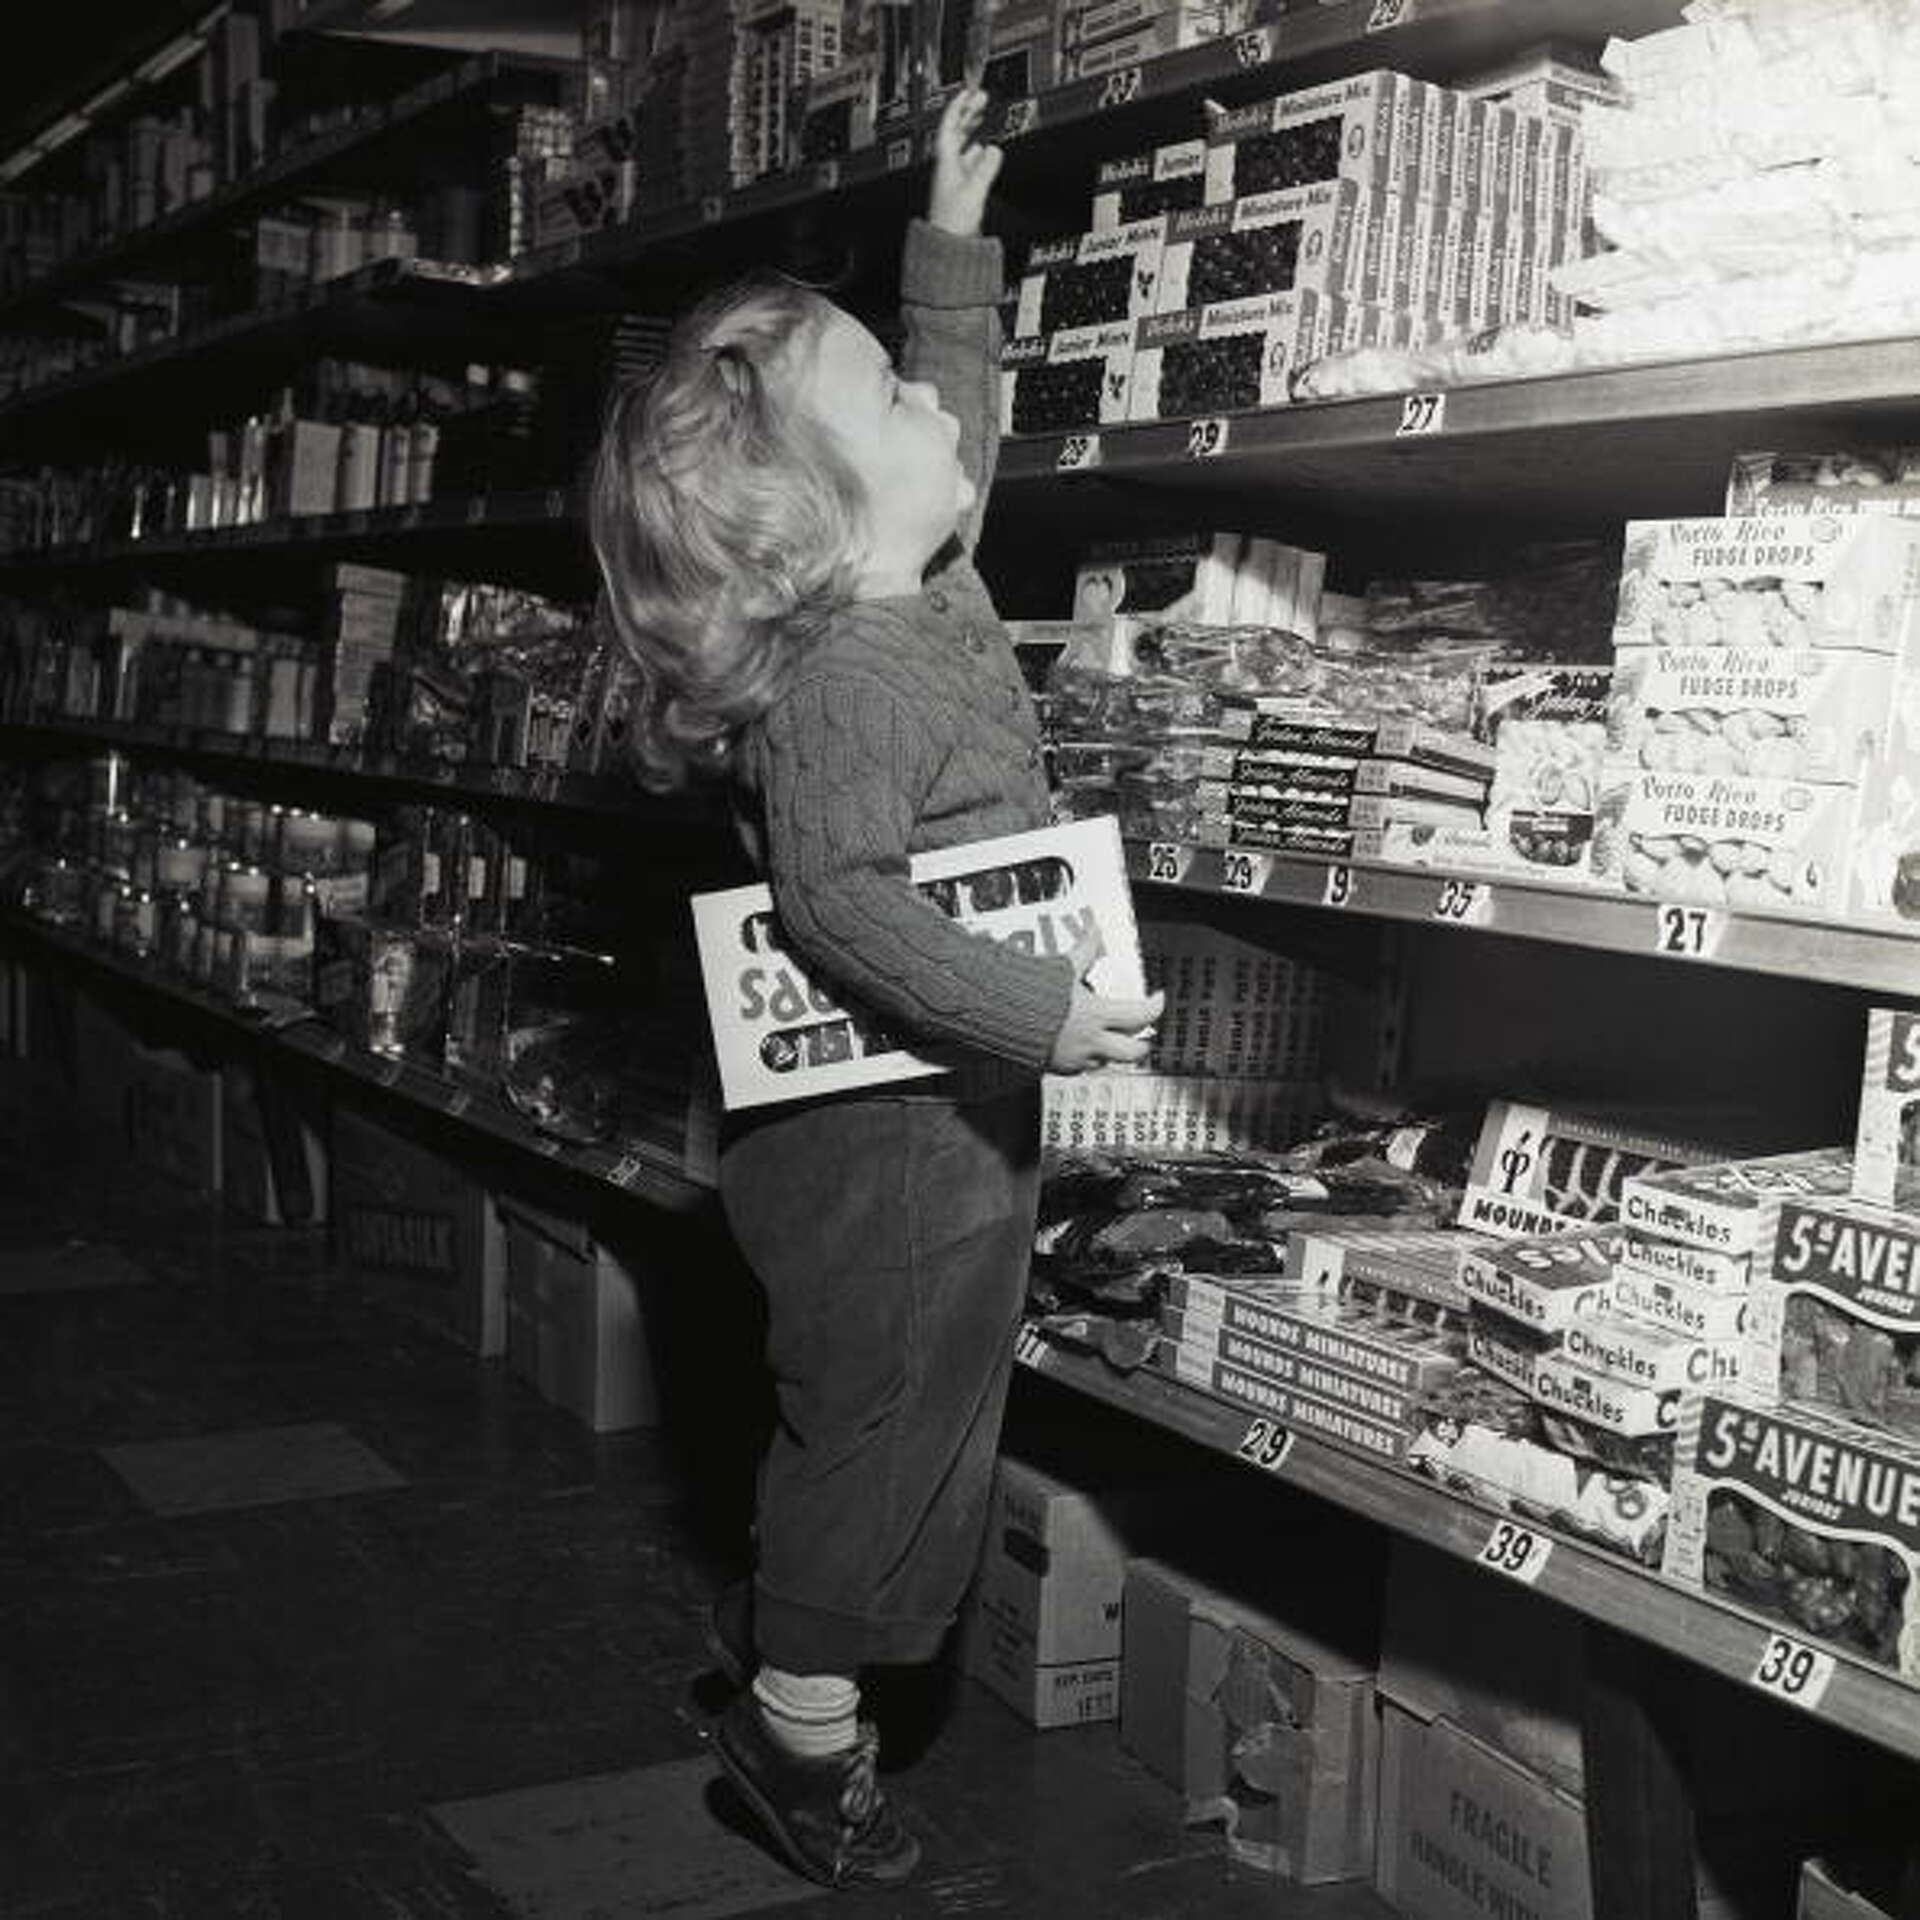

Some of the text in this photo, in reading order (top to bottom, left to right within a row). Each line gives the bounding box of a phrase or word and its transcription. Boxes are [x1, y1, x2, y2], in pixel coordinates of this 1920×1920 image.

[1402, 397, 1436, 431] 27
[1692, 545, 1815, 566] FUDGE DROPS
[1680, 676, 1800, 699] FUDGE DROPS
[1663, 803, 1786, 833] FUDGE DROPS
[1224, 855, 1252, 889] 29
[1331, 867, 1349, 902] 9
[1436, 881, 1474, 917] 35
[1664, 907, 1707, 953] 27
[1627, 1195, 1732, 1243] Chuckles
[1627, 1237, 1717, 1286] Chuckles
[1462, 1263, 1546, 1321] Chuckles
[1616, 1281, 1706, 1331] Chuckles
[1231, 1302, 1408, 1386] MOUNDS MINIATURES
[1225, 1336, 1402, 1421] MOUNDS MINIATURES
[1538, 1373, 1624, 1424] Chuckles
[1219, 1369, 1395, 1456] MOUNDS MINIATURES
[1240, 1421, 1287, 1464] 29
[1755, 1427, 1920, 1527] AVENUE
[1486, 1523, 1533, 1572] 39
[1759, 1640, 1815, 1694] 39
[1451, 1790, 1551, 1890] FRAGILE
